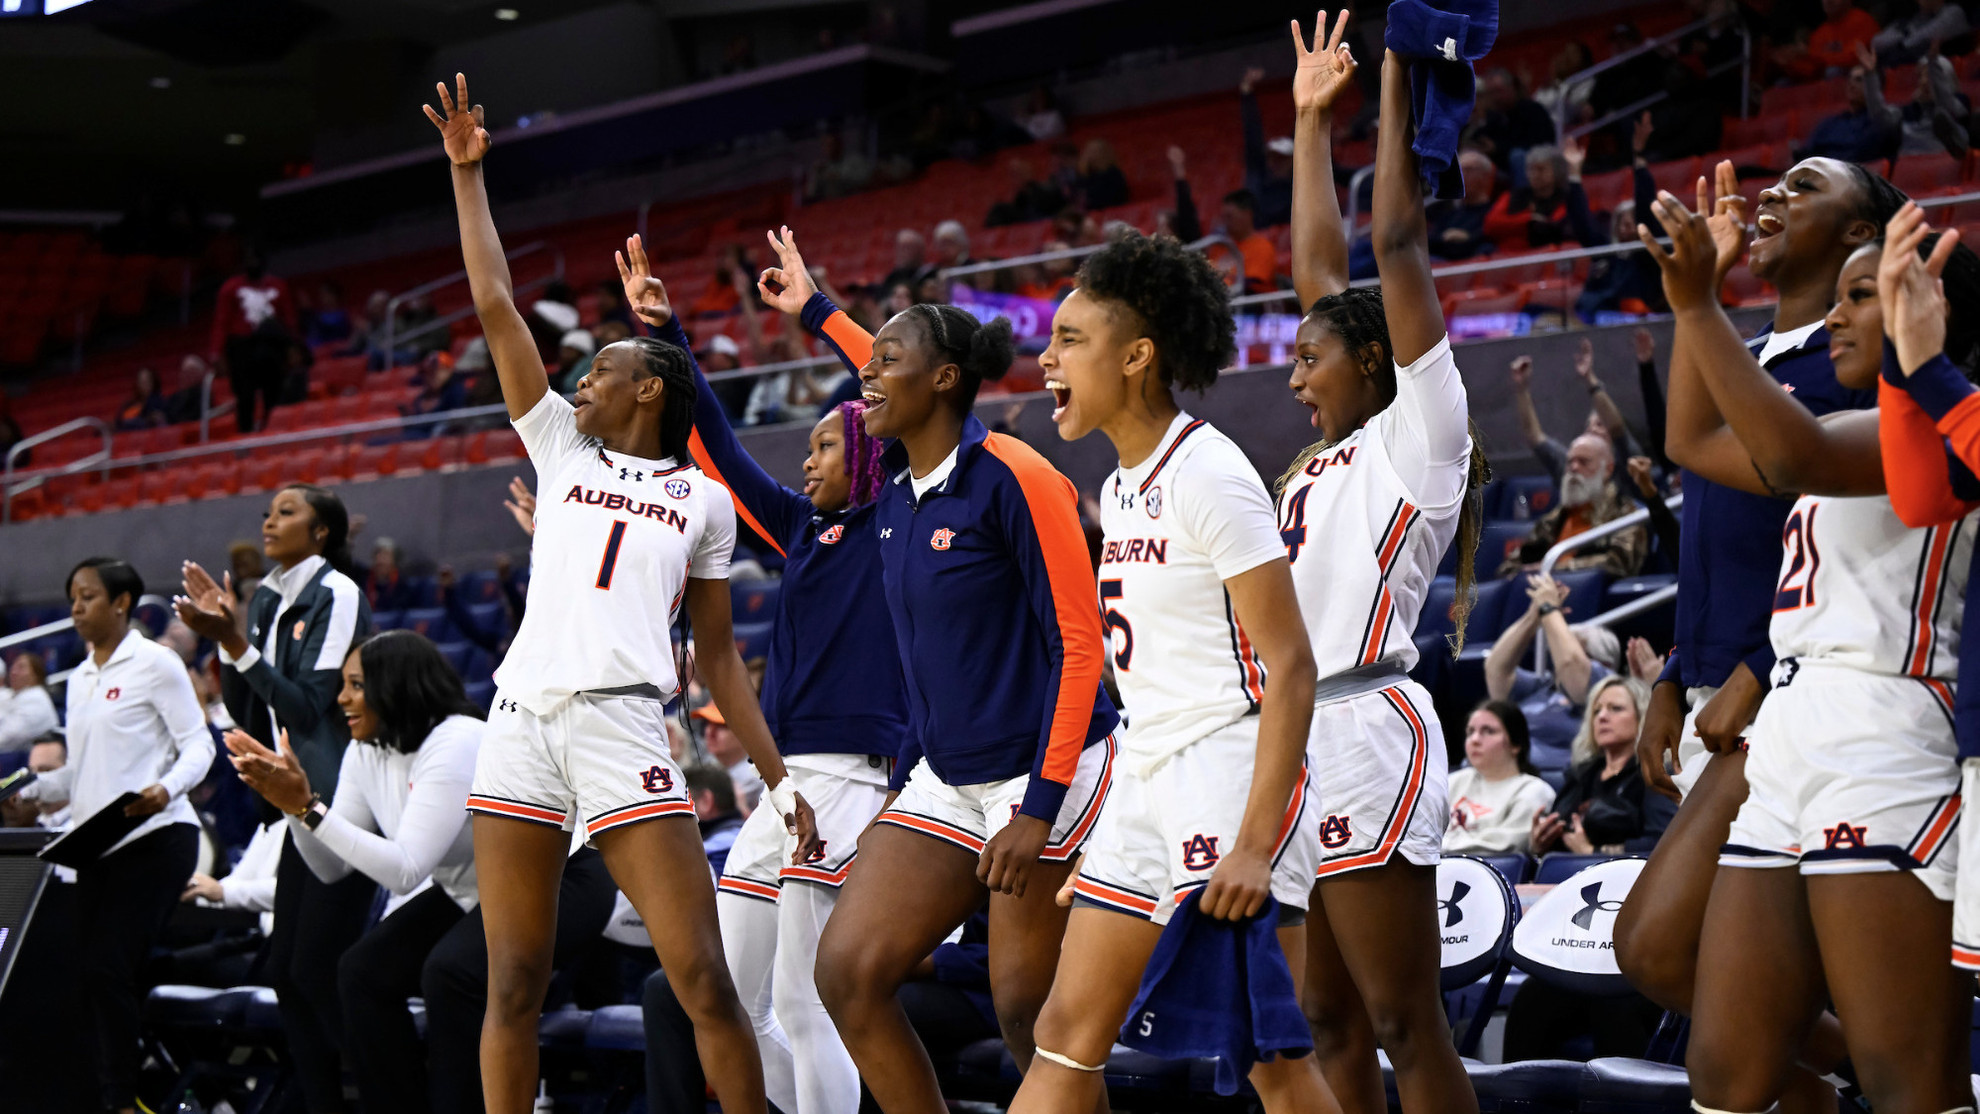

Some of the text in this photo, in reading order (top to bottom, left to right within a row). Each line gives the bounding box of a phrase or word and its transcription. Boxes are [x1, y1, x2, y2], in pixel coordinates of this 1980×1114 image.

[665, 479, 690, 499] SEC
[563, 485, 688, 535] AUBURN
[595, 519, 628, 591] 1
[1101, 538, 1168, 565] BURN
[1772, 503, 1820, 614] 21
[1099, 578, 1134, 672] 5
[1440, 934, 1469, 945] MOUR
[1552, 937, 1596, 949] UNDER
